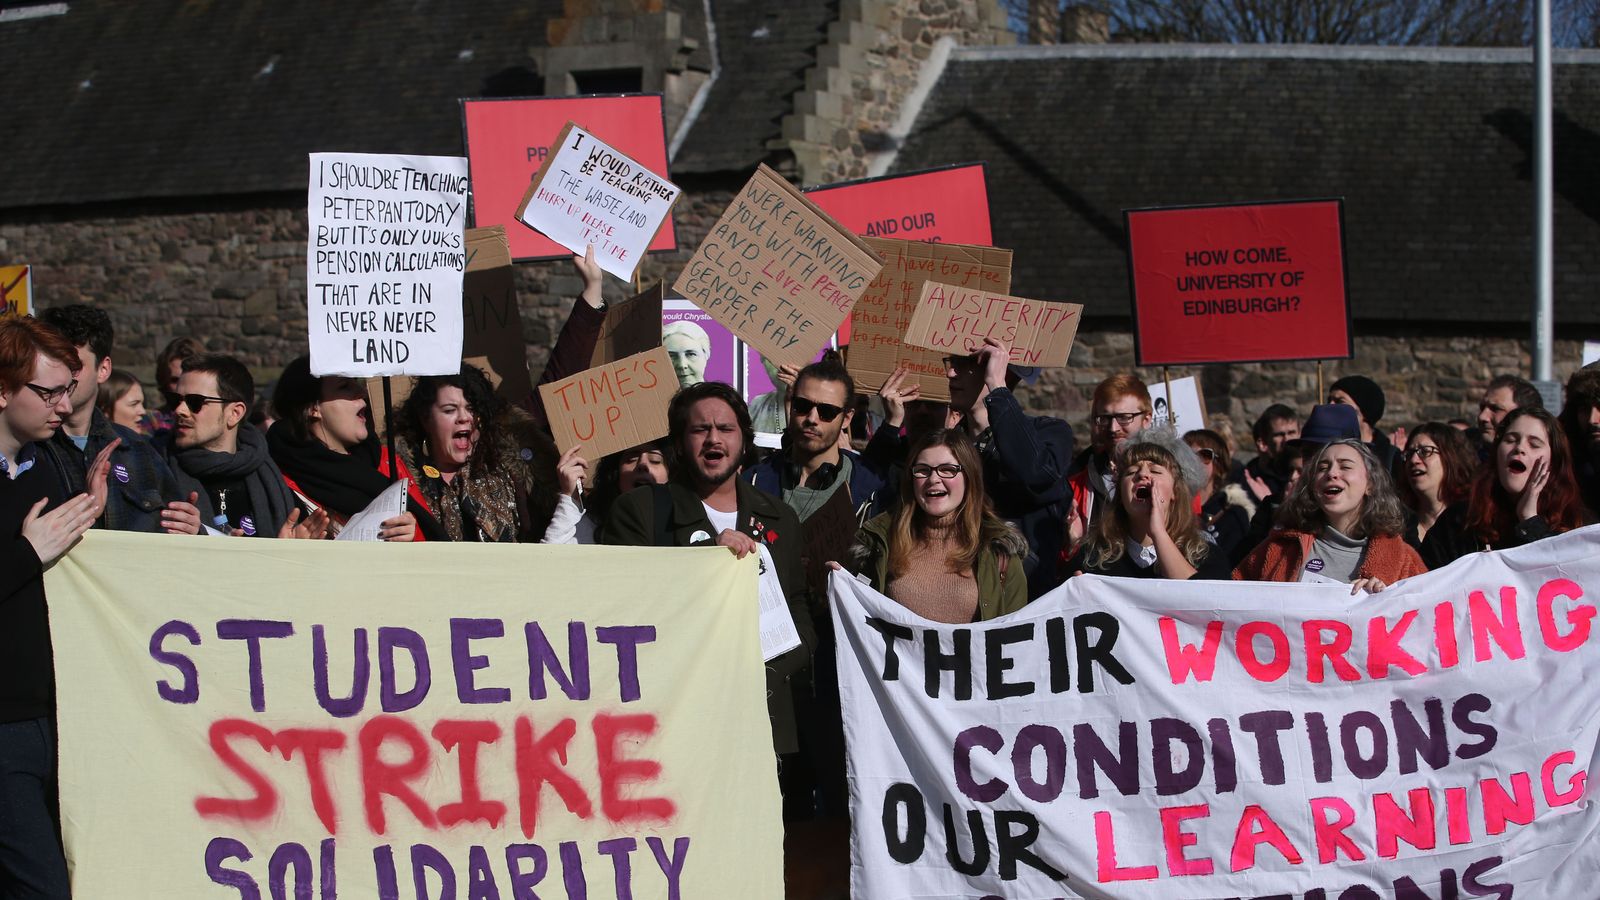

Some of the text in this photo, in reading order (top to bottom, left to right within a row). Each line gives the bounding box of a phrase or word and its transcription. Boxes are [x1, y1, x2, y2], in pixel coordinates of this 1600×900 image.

[320, 161, 323, 188] I
[402, 167, 468, 195] TEACHING
[556, 169, 583, 196] THE
[571, 133, 675, 202] I WOULD RATHER
[579, 160, 652, 205] BE TEACHING
[404, 200, 460, 227] TODAY
[537, 187, 616, 237] HURRY UP PLEASE
[867, 212, 936, 237] AND OUR
[317, 225, 350, 247] BUT
[352, 225, 377, 245] IT'S
[380, 229, 419, 246] ONLY
[601, 239, 629, 262] TIME
[316, 250, 381, 275] PENSION
[385, 251, 465, 272] CALCULATIONS
[715, 224, 803, 297] AND LOVE
[728, 201, 851, 313] YOU WITH PEACE
[794, 219, 865, 290] WARNING
[897, 248, 1001, 285] have to free
[1185, 247, 1292, 266] HOW COME,
[315, 282, 432, 306] THAT ARE IN
[703, 243, 813, 332] CLOSE THE
[1176, 271, 1304, 292] UNIVERSITY OF
[690, 261, 758, 322] GENDER
[762, 318, 799, 349] PAY
[863, 294, 889, 312] ace,
[927, 287, 1076, 333] AUSTERITY
[1183, 296, 1301, 316] EDINBURGH?
[326, 311, 437, 334] NEVER NEVER
[853, 329, 868, 342] to
[946, 314, 1017, 342] KILLS
[352, 338, 410, 364] LAND
[932, 330, 1042, 363] WOEN
[553, 359, 658, 412] TIME'S
[572, 405, 622, 441] UP
[864, 611, 1136, 701] THEIR
[1157, 578, 1598, 685] WORKING
[149, 617, 657, 718] STUDENT
[953, 693, 1498, 803] CONDITIONS
[194, 712, 679, 840] STRIKE
[882, 750, 1588, 883] OUR LEARNING
[204, 836, 691, 900] SOLIDARITY
